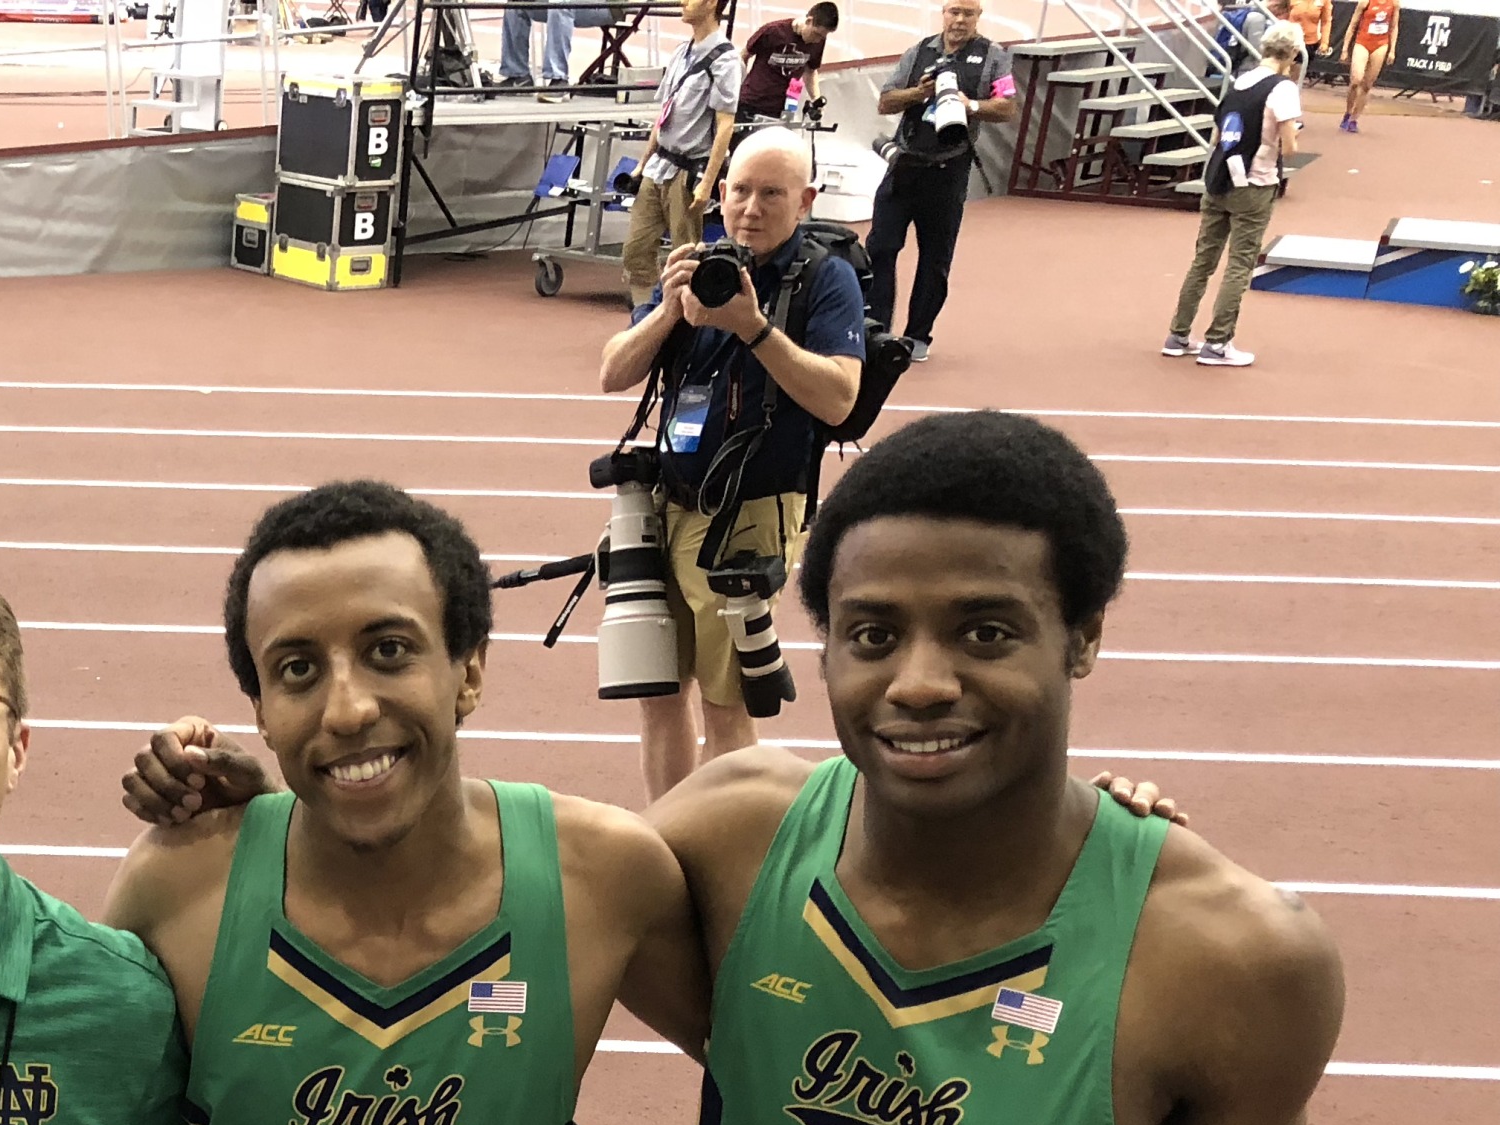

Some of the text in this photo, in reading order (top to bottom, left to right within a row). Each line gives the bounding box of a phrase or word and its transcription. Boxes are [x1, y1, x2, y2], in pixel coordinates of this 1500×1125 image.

[368, 127, 388, 155] B
[354, 212, 374, 240] B
[750, 973, 813, 1003] ACC
[232, 1023, 298, 1046] ACC
